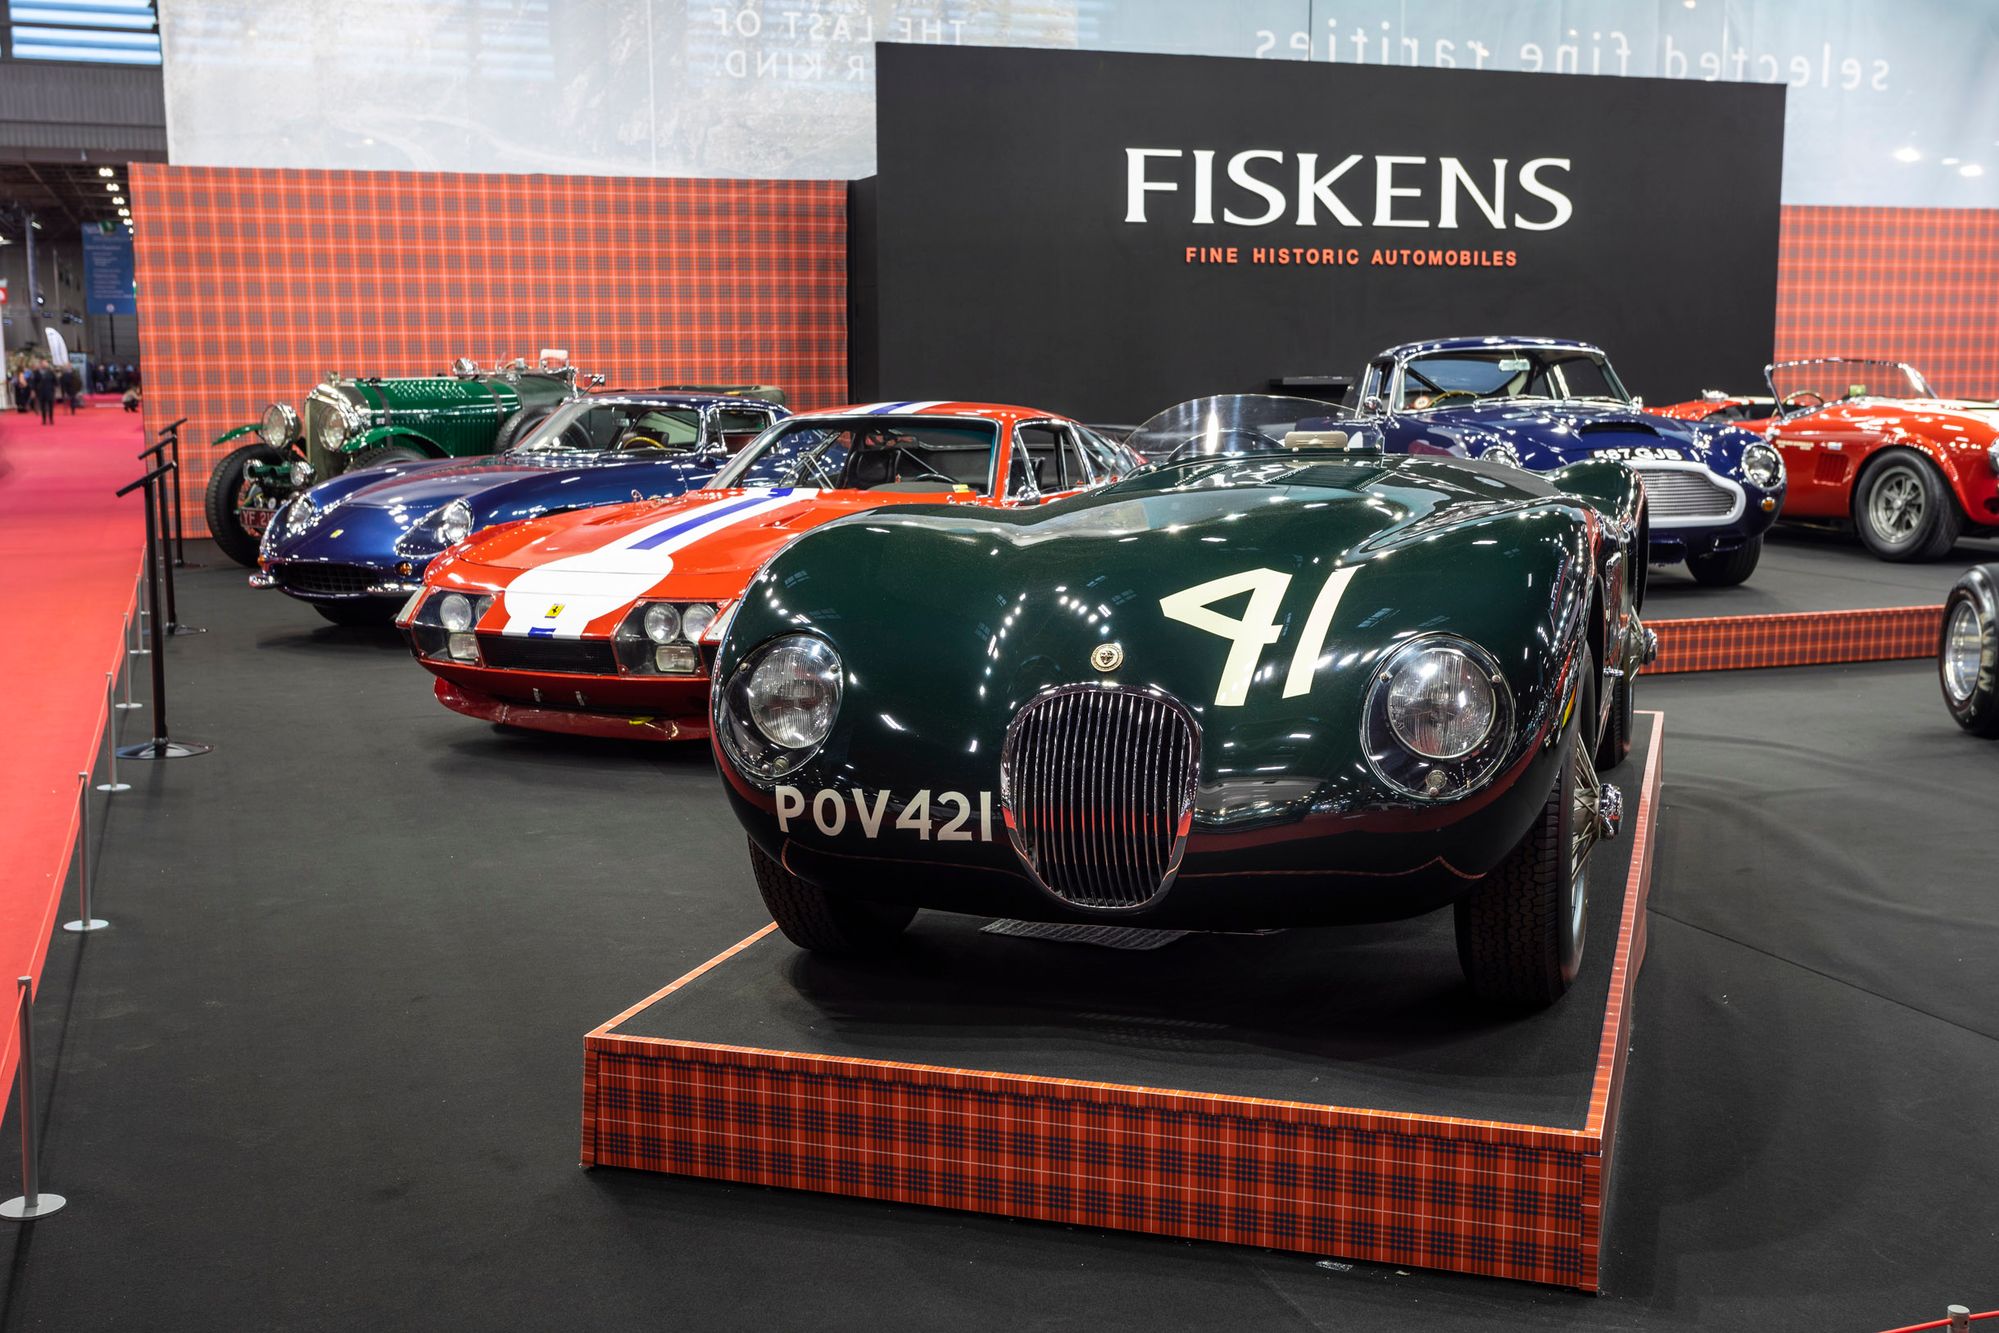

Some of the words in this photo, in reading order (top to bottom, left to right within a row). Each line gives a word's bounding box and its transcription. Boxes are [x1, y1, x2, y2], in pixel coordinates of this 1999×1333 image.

[1124, 148, 1573, 231] FISKENS
[1185, 247, 1239, 264] FINE
[1253, 248, 1360, 265] HISTORIC
[1371, 249, 1518, 267] AUTOMOBILES
[1159, 567, 1366, 706] 41
